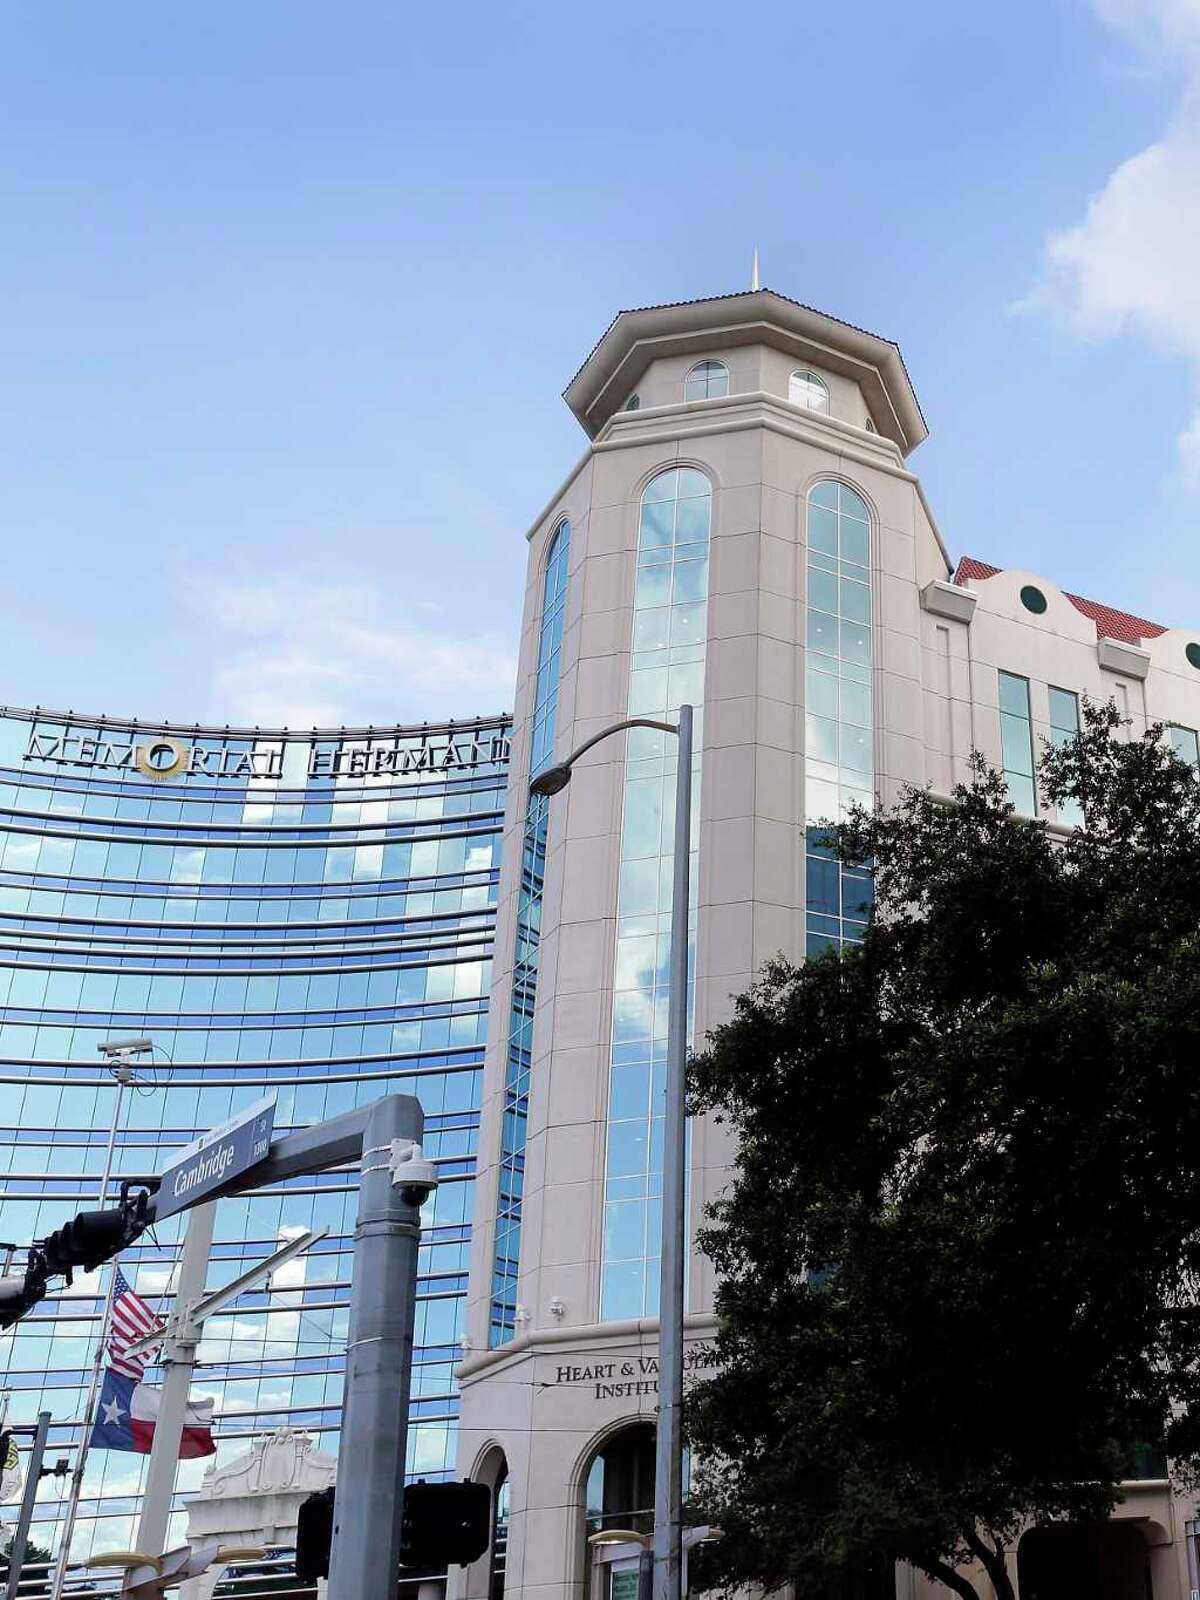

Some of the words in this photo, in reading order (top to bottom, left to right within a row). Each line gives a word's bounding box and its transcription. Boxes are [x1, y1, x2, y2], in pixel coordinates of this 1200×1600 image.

[22, 734, 283, 780] MEMORIAL
[173, 1144, 235, 1198] Cambridge
[556, 1363, 616, 1383] HEART
[620, 1361, 634, 1376] &
